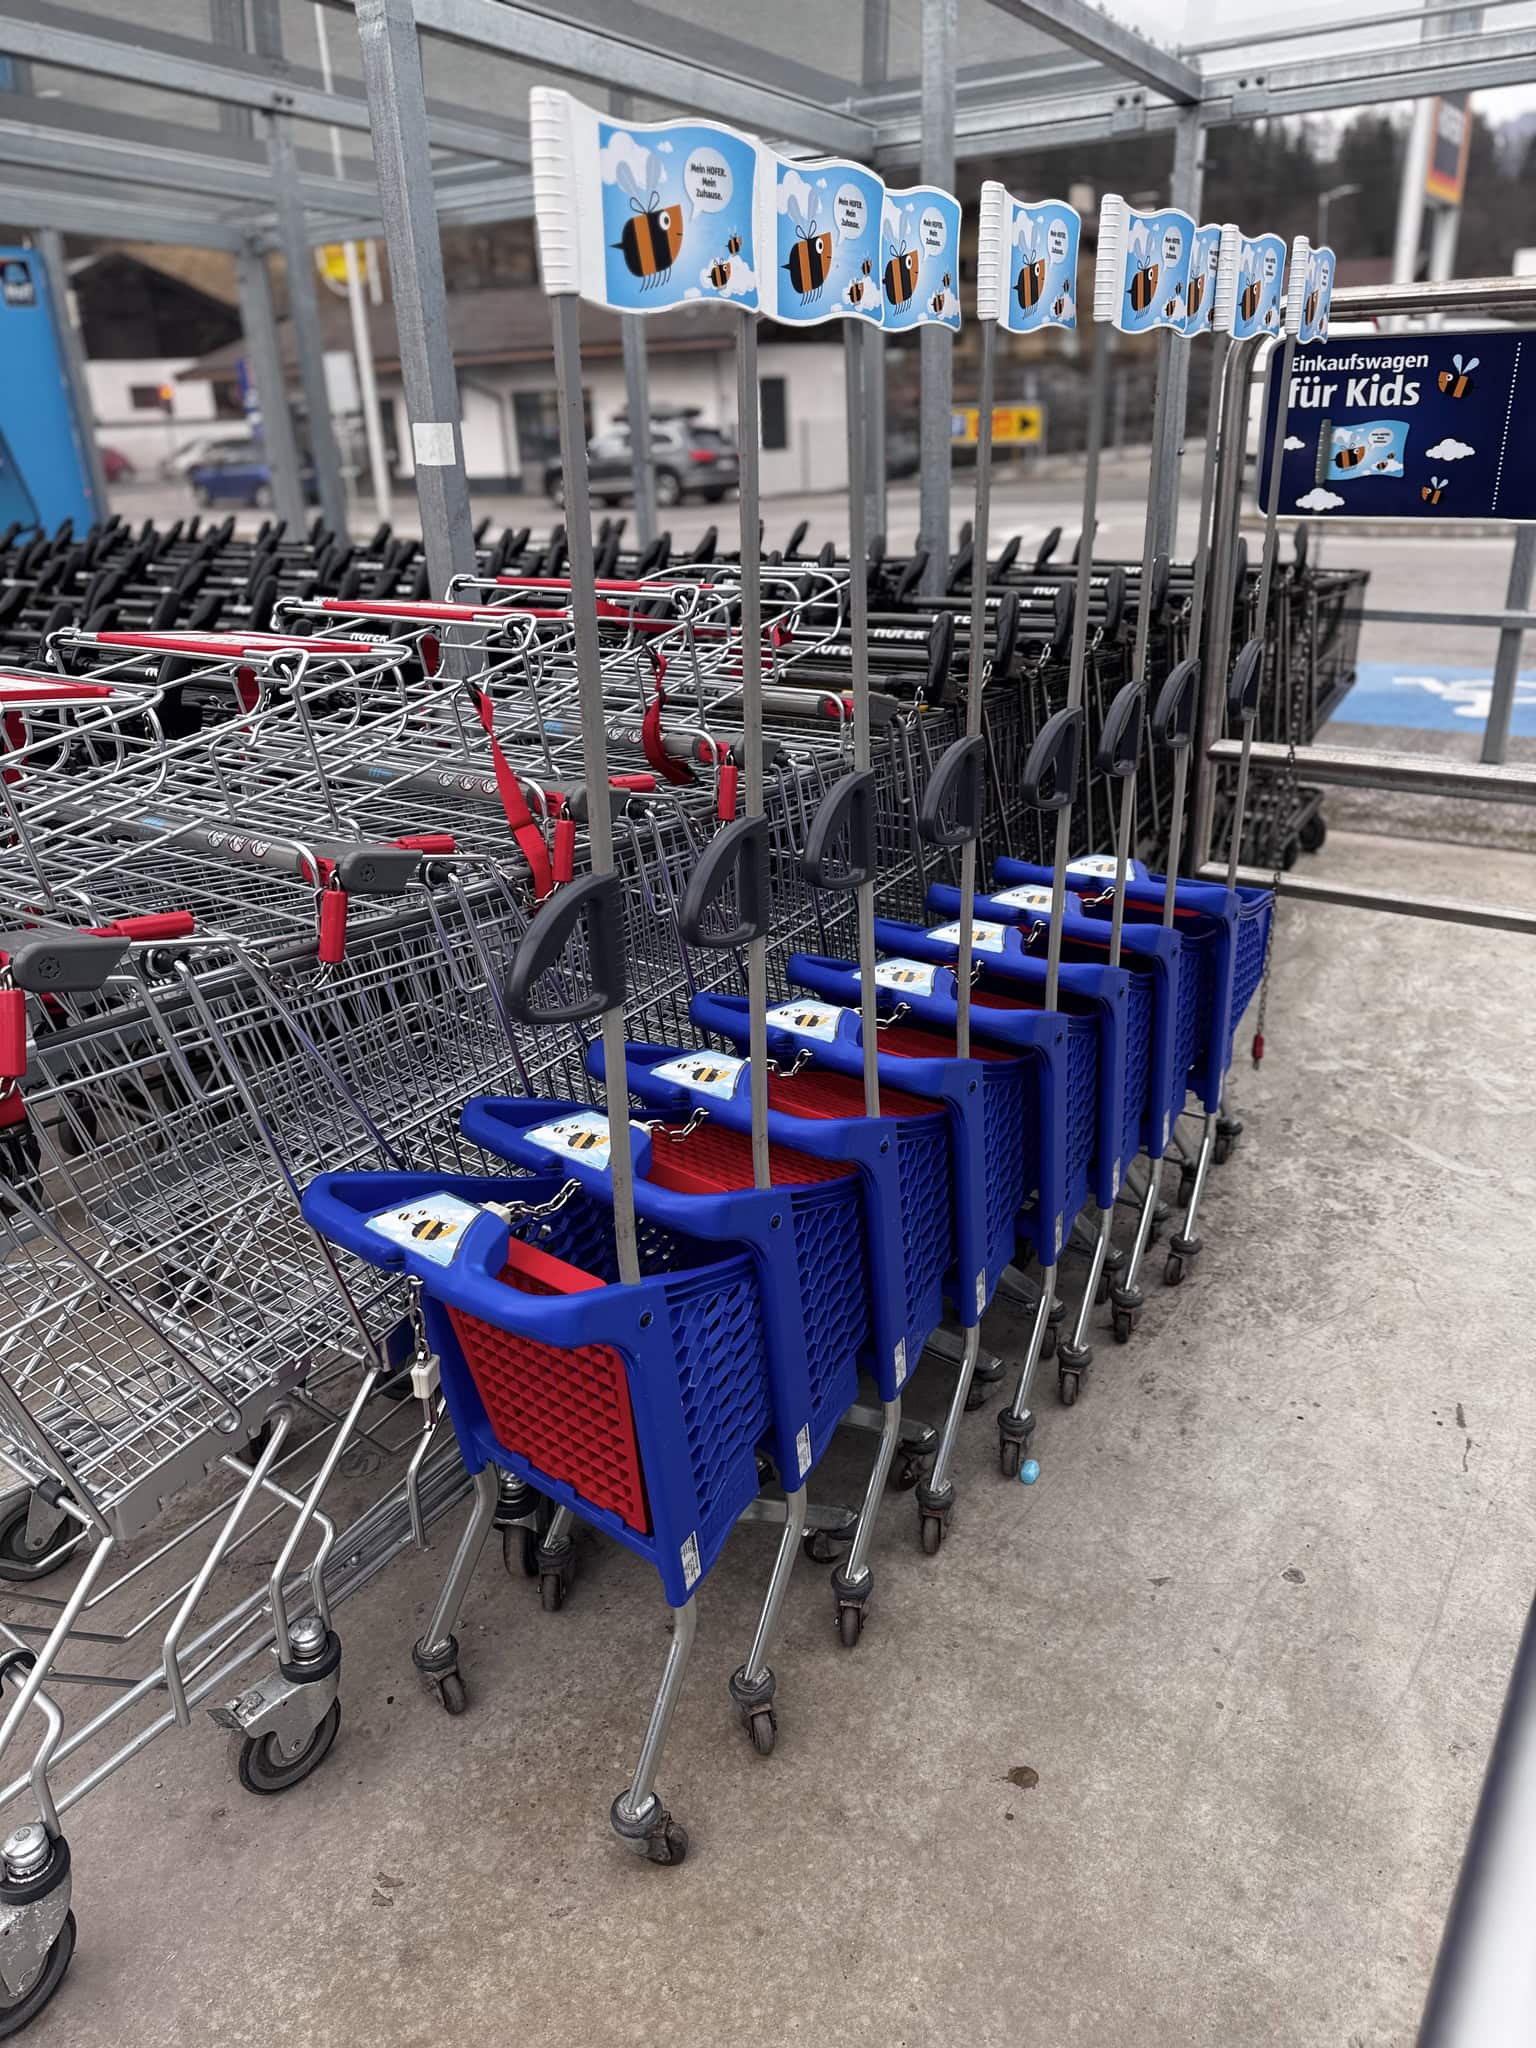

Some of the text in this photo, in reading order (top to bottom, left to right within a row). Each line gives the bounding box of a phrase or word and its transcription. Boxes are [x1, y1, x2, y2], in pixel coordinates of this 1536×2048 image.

[691, 163, 706, 174] Mein
[702, 177, 717, 188] Mein
[1291, 353, 1429, 373] Einkaufswagen
[1287, 373, 1421, 409] für Kids
